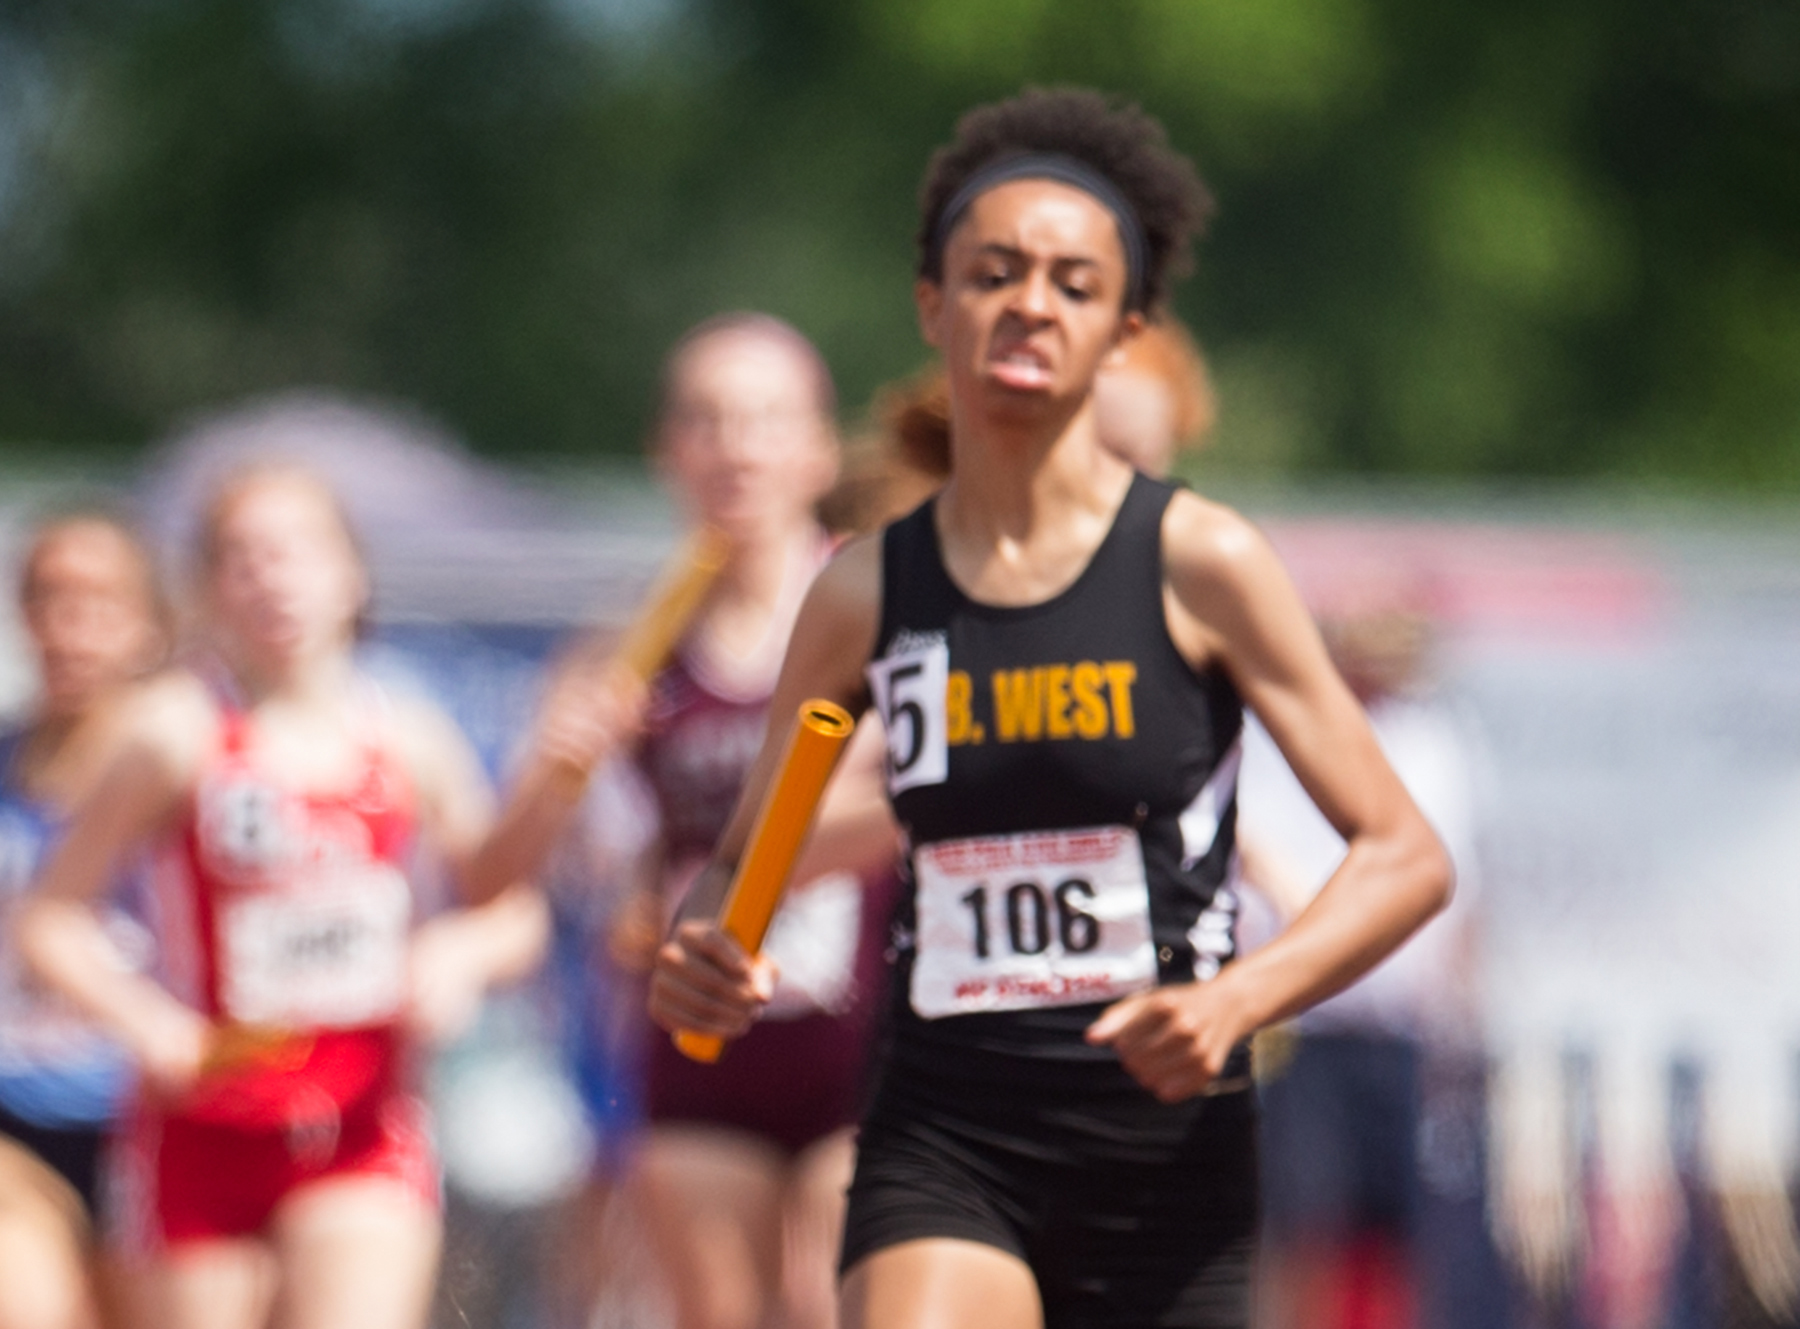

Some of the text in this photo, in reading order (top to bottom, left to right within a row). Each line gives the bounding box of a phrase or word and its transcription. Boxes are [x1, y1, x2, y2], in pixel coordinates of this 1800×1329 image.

[890, 662, 925, 774] 5
[990, 659, 1138, 743] WEST
[961, 878, 1101, 959] 106
